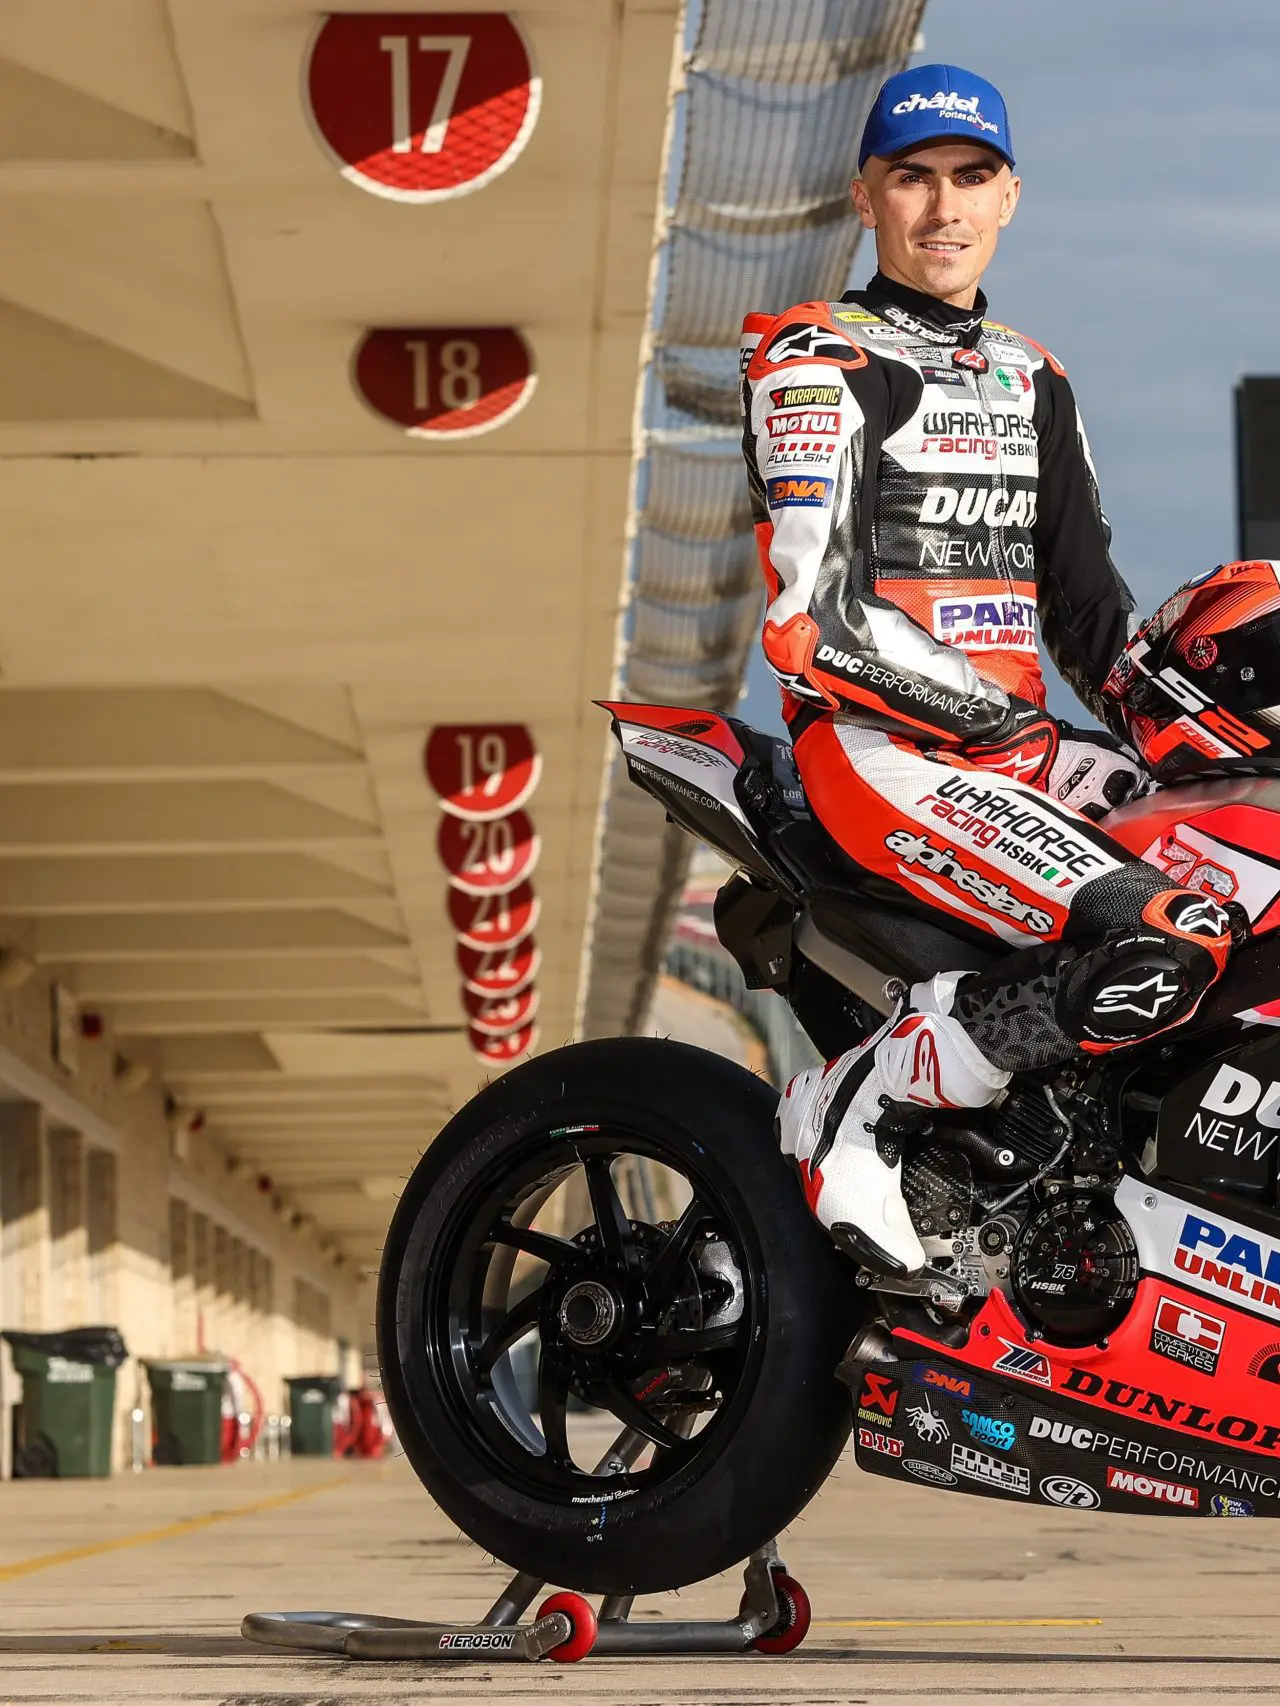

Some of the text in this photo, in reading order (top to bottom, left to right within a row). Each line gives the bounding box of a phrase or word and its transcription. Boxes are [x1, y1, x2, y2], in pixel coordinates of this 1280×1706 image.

[380, 36, 472, 153] 17
[892, 92, 980, 114] châtel
[939, 110, 966, 121] Portes
[966, 115, 977, 124] du
[885, 307, 958, 344] alpinestars
[405, 340, 482, 411] 18
[771, 414, 838, 435] MOTUL
[767, 453, 831, 465] FULLSIX
[921, 438, 998, 460] racing
[772, 480, 826, 499] DNA
[919, 541, 1034, 569] NEW YOR
[940, 601, 1035, 629] PART
[942, 629, 1036, 645] UNLIMIT
[1129, 640, 1271, 757] LS2
[629, 738, 674, 753] racing
[639, 733, 728, 768] WARHORSE
[456, 734, 507, 796] 19
[630, 758, 722, 811] DUCPERFORMANCE.COM
[915, 794, 1050, 878] racing HSBK
[936, 775, 1105, 878] WARHORSE
[460, 819, 515, 874] 20
[884, 829, 1054, 933] alpinestars
[470, 892, 511, 933] 21
[1183, 1112, 1280, 1161] NEW
[1030, 1281, 1067, 1292] HSBK
[1052, 1264, 1076, 1280] 76
[1154, 1331, 1215, 1362] COMPETITION
[1154, 1338, 1213, 1372] WERKES
[633, 1371, 669, 1401] brembo
[996, 1363, 1051, 1385] MOTOAMERICA
[961, 1409, 1015, 1438] SAMCO
[974, 1431, 1009, 1448] sport
[952, 1456, 1029, 1488] FULLSIX
[571, 1492, 613, 1503] marchesini
[1109, 1471, 1197, 1507] MOTUL
[439, 1633, 516, 1649] PIEROBON
